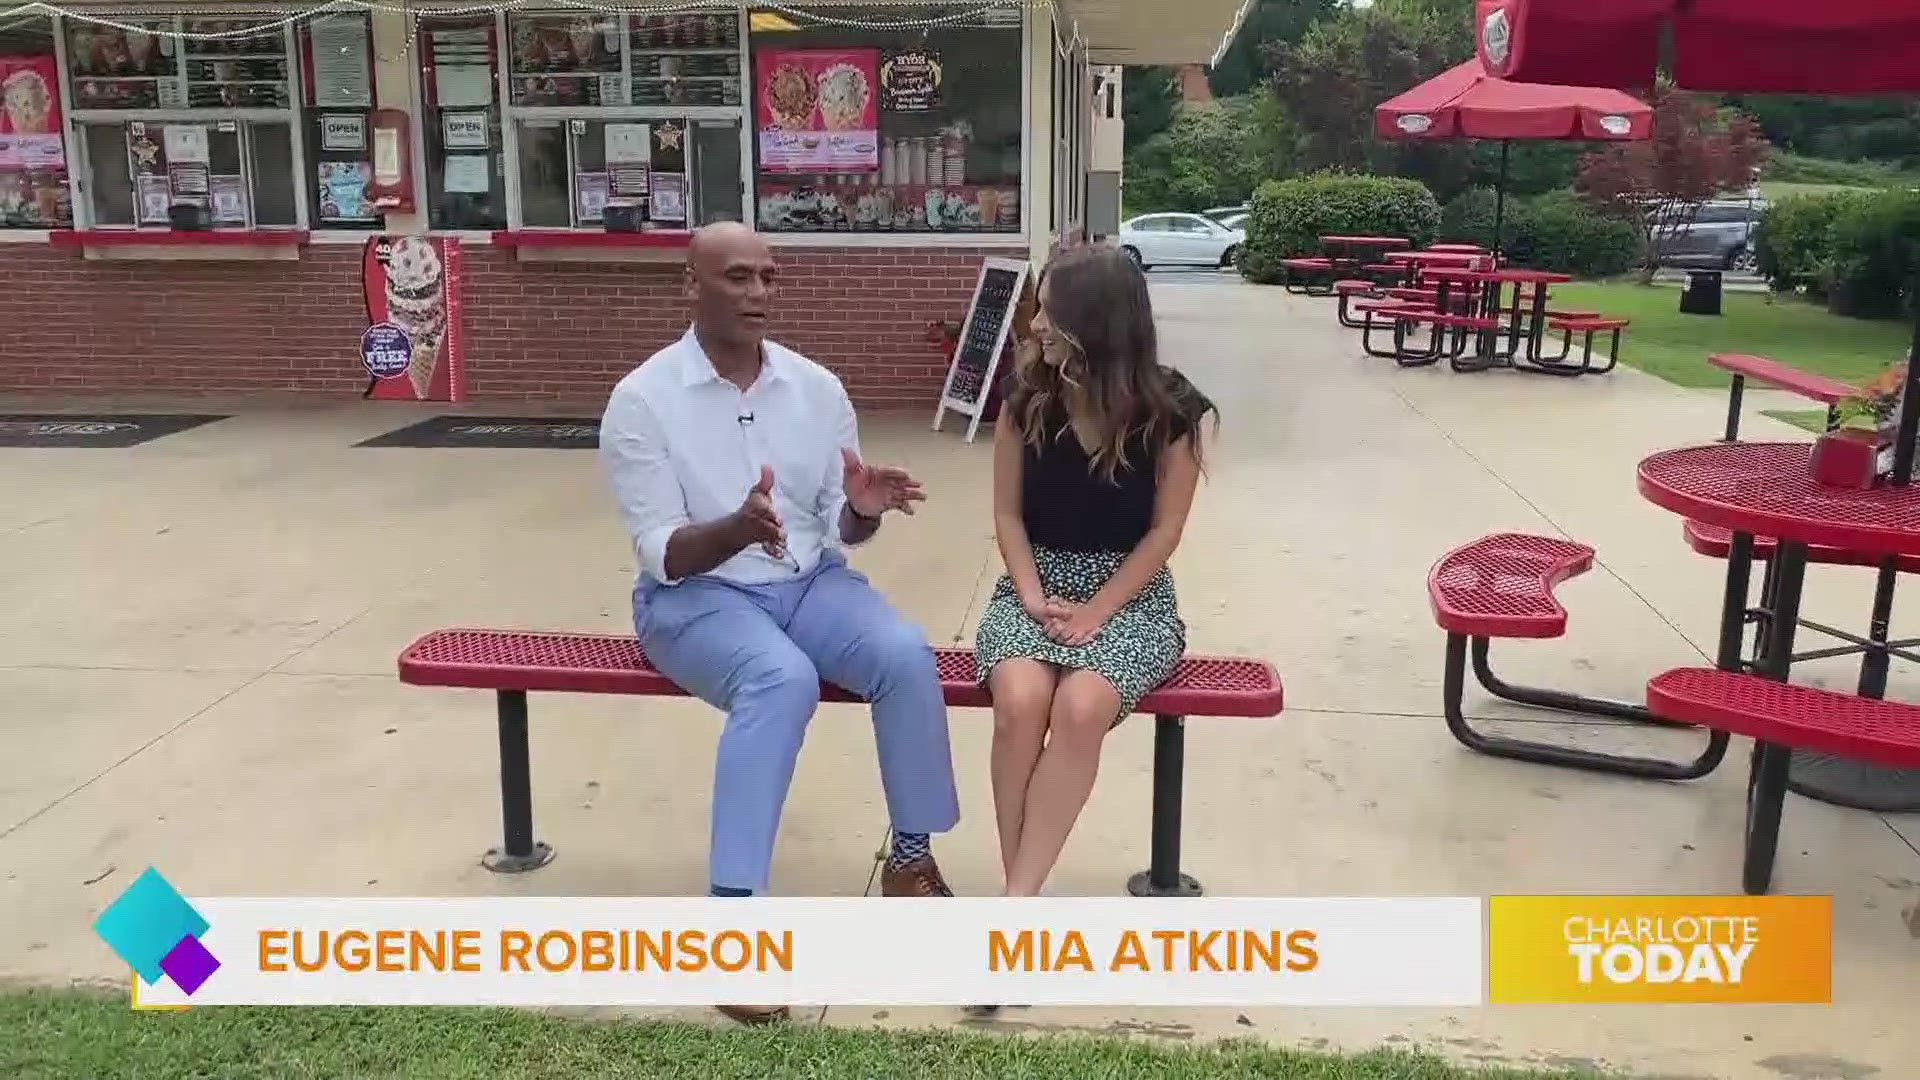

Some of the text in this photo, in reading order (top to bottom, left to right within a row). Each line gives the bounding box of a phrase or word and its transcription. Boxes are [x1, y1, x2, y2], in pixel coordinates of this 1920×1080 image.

[328, 124, 359, 133] OPEN
[448, 121, 482, 132] OPEN
[365, 350, 409, 363] FREE
